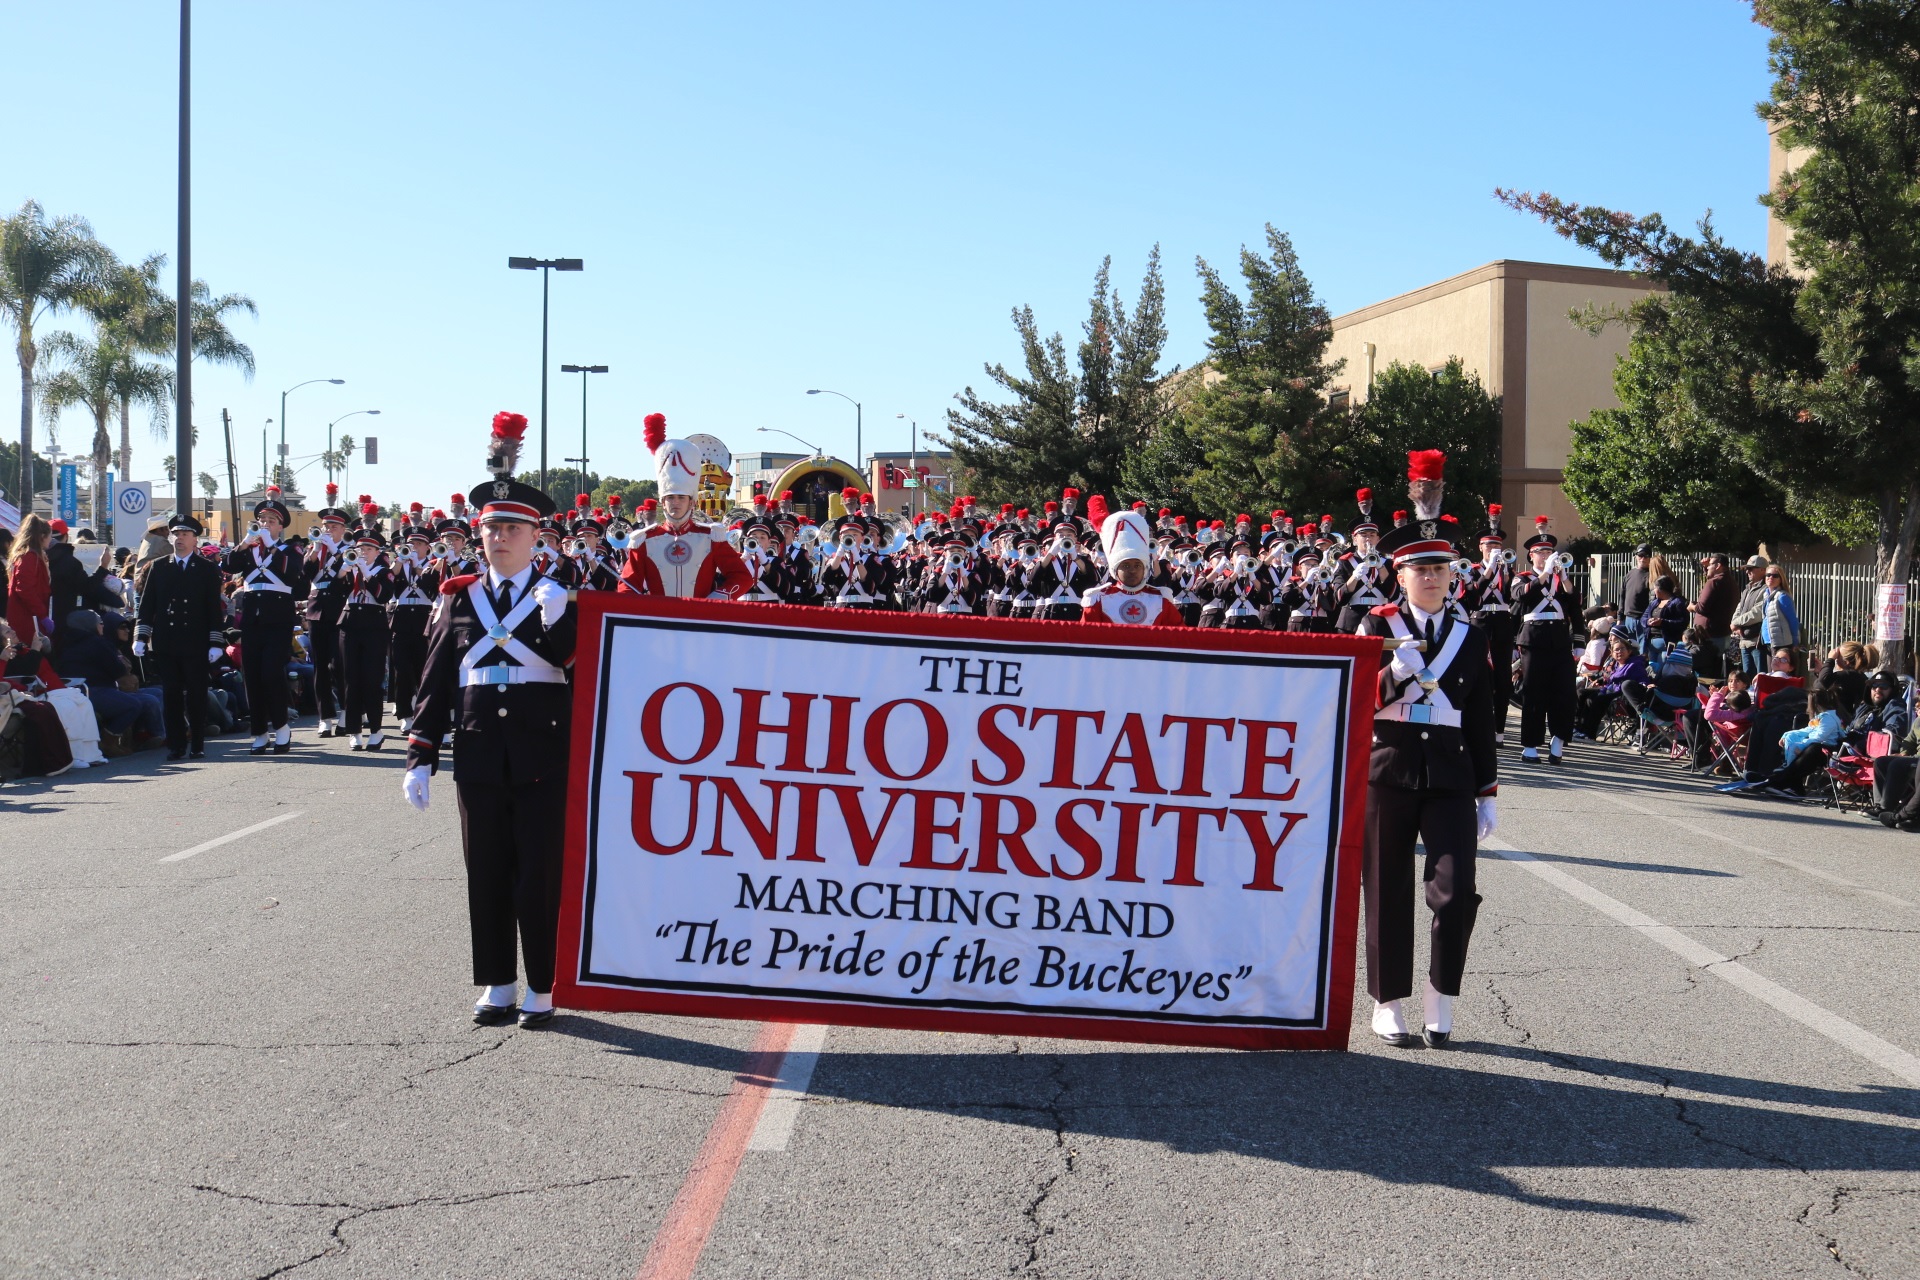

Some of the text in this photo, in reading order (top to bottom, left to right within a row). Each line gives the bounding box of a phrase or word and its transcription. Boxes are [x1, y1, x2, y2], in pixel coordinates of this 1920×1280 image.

[919, 655, 1023, 697] THE
[640, 681, 1301, 802] OHIO STATE
[622, 770, 1309, 893] UNIVERSITY
[734, 872, 1176, 939] MARCHING BAND
[655, 918, 1253, 1012] “The Pride of the Buckeyes”
